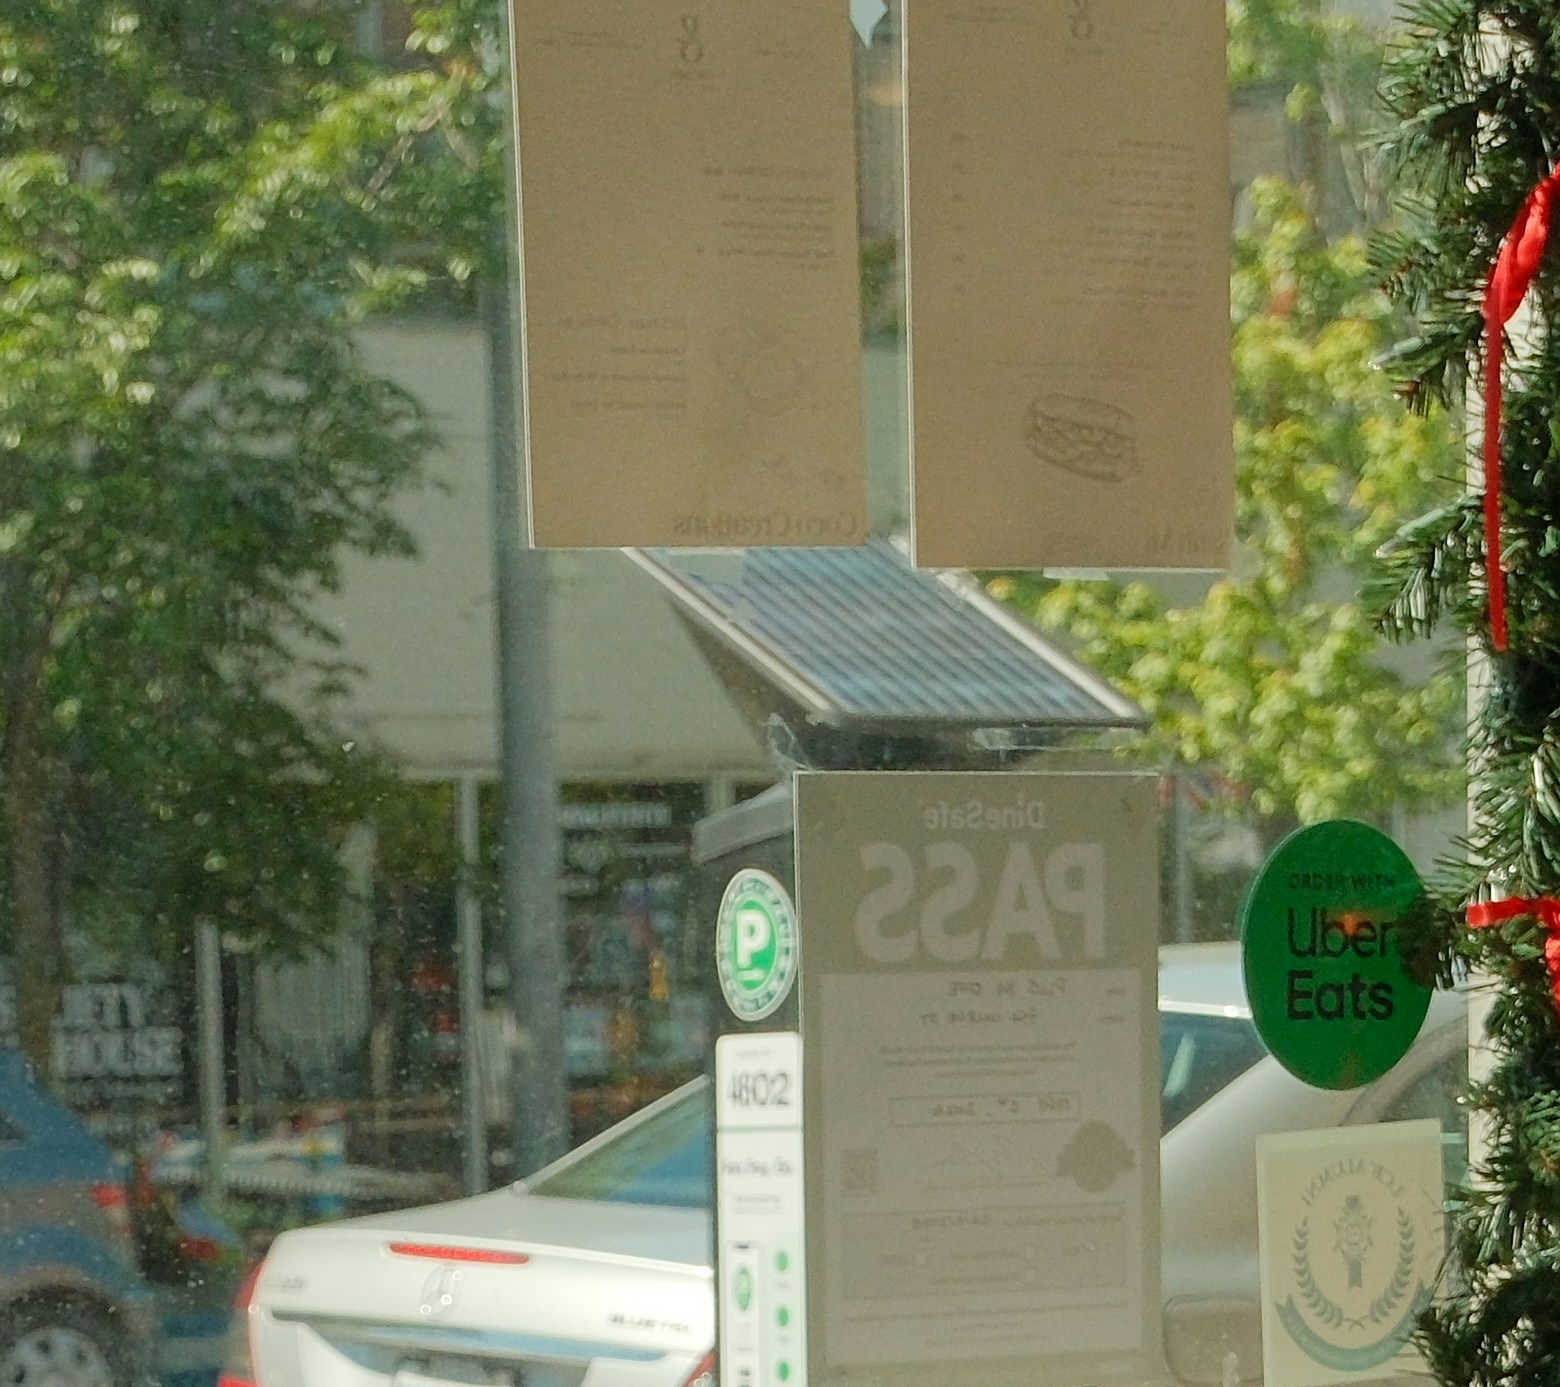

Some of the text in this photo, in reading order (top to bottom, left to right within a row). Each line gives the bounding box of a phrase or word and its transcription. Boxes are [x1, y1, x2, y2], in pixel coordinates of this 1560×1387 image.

[735, 908, 772, 970] P
[1287, 906, 1395, 959] Uber
[1287, 968, 1394, 1021] Eats
